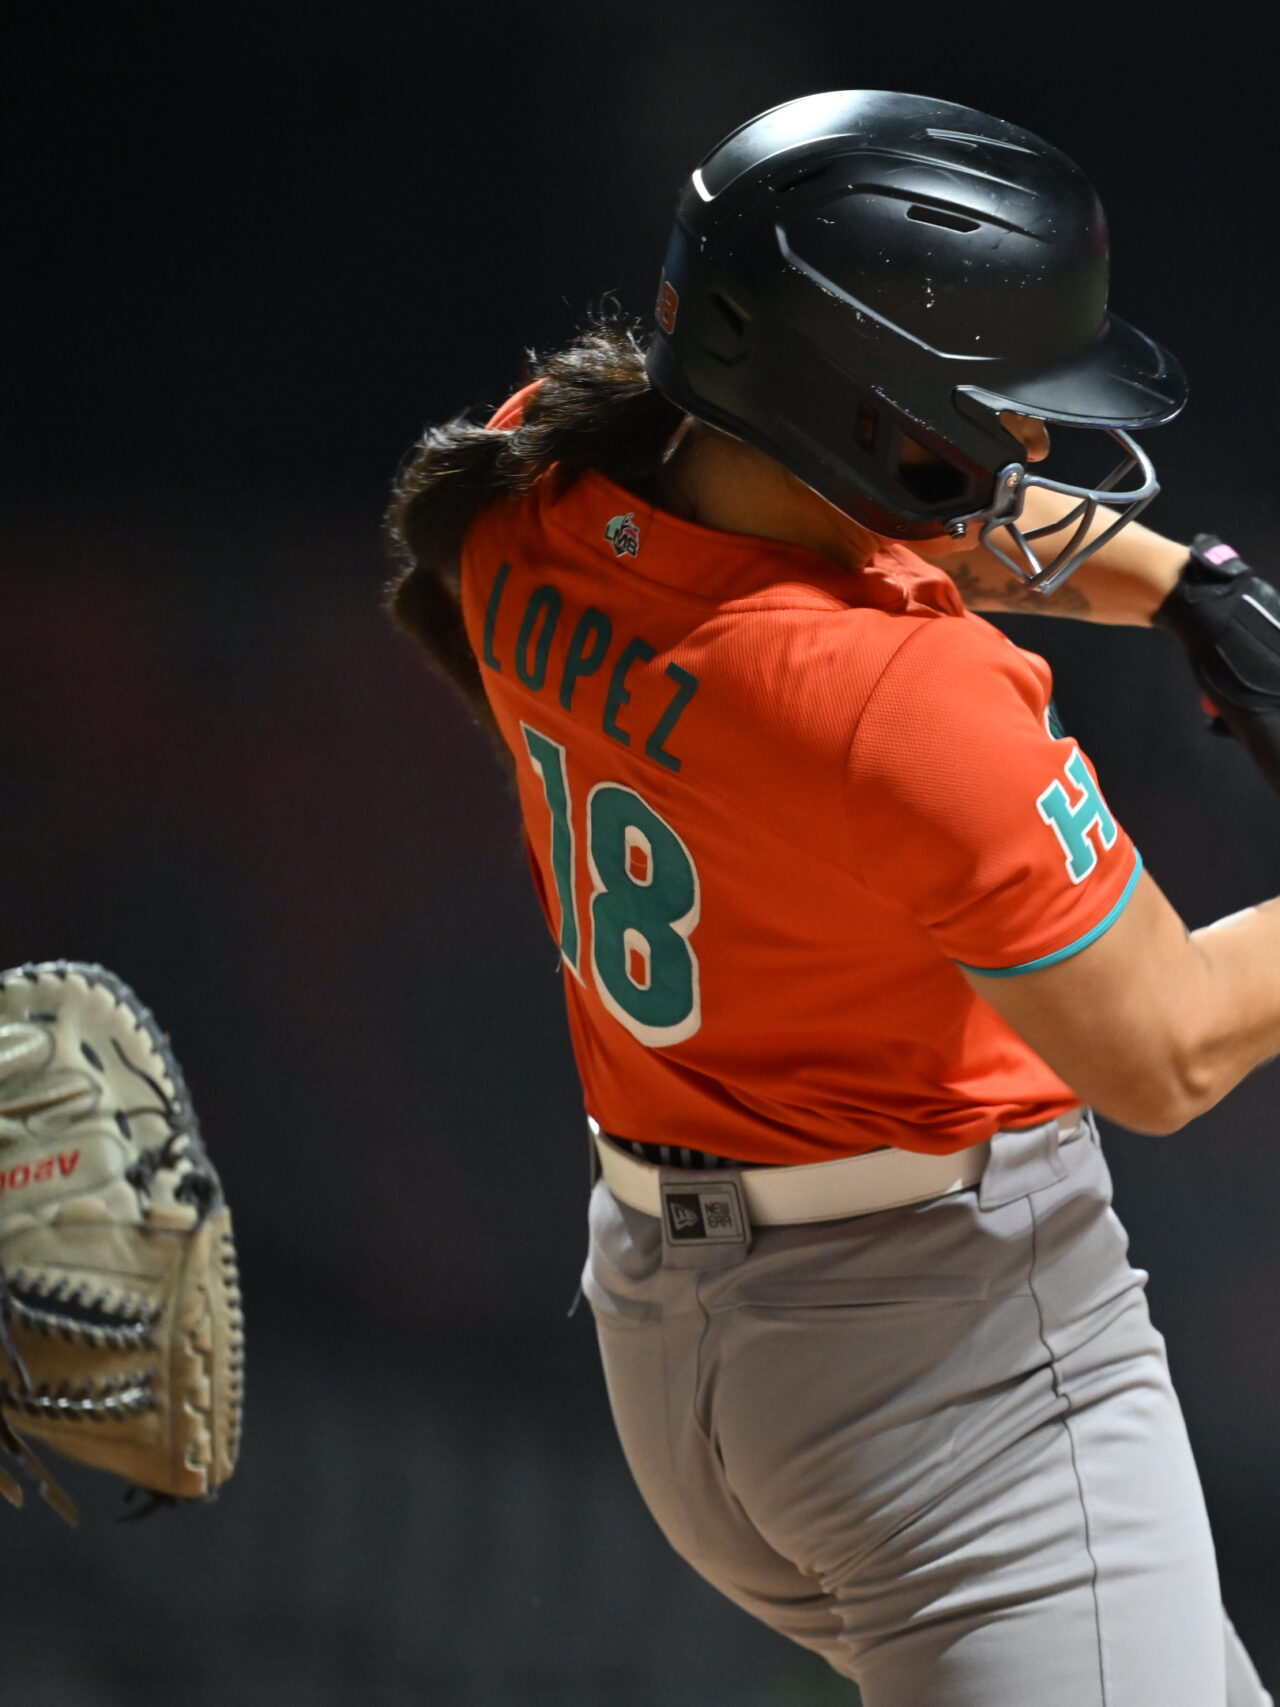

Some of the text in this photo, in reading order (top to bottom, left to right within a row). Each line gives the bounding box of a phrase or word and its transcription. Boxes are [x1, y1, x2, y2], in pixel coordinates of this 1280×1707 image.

[483, 562, 698, 773] LOPEZ
[519, 720, 702, 1047] 18
[1036, 745, 1117, 885] H
